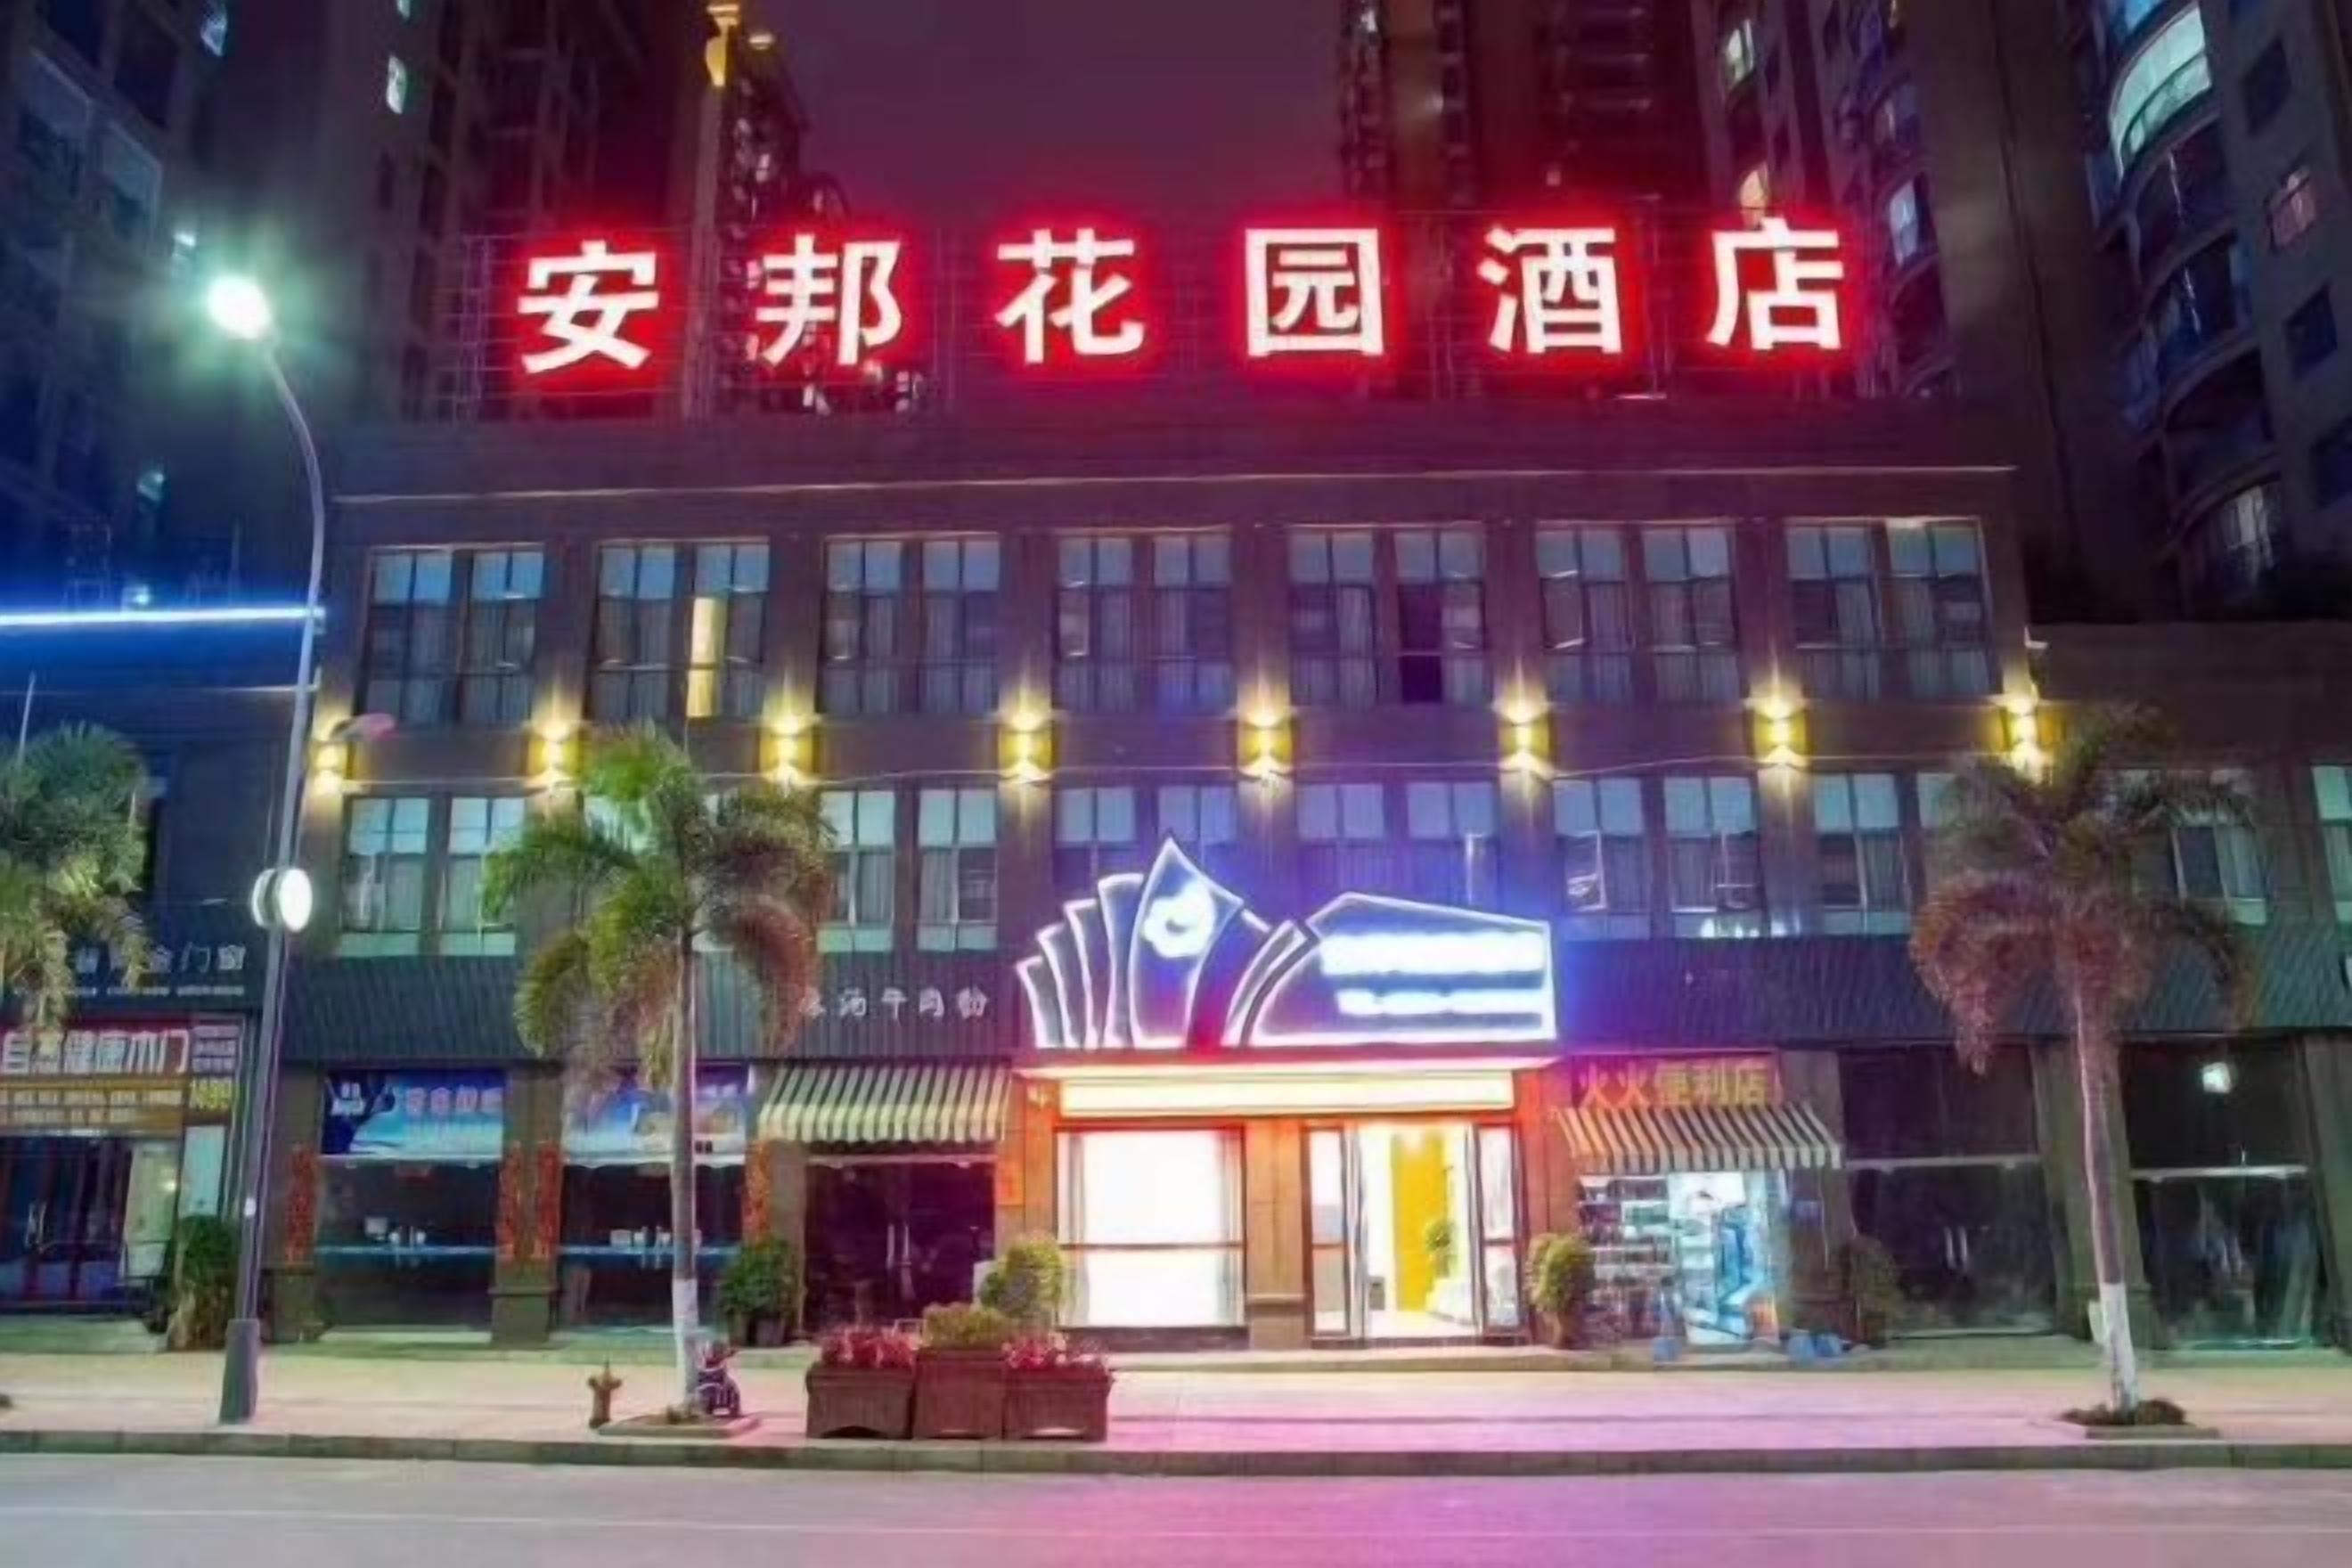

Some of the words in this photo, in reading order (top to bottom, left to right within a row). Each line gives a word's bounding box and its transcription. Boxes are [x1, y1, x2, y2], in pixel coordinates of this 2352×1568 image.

[516, 216, 1846, 374] 安邦花园酒店
